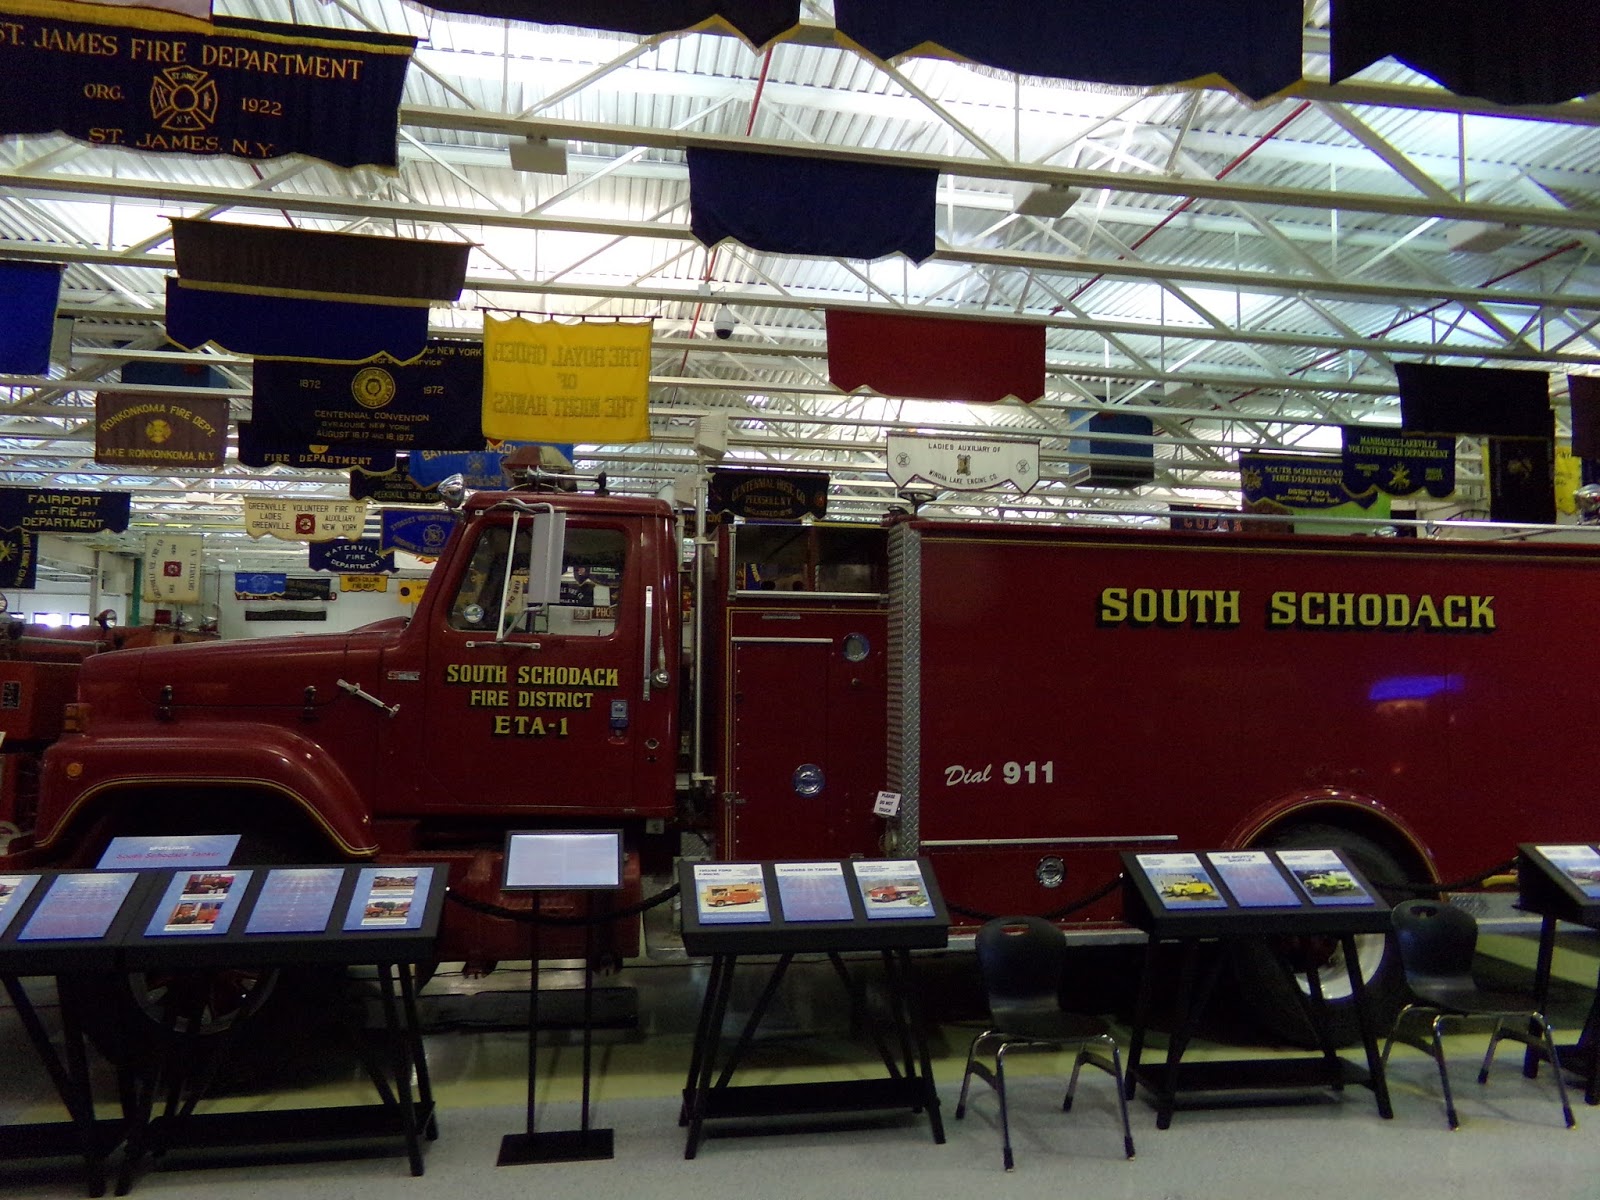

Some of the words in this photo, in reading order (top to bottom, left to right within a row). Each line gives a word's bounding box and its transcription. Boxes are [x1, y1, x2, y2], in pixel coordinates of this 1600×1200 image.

[34, 26, 118, 56] JAMES
[130, 38, 187, 64] FIRE
[201, 44, 364, 80] DEPARTMENT
[83, 83, 125, 100] ORG.
[241, 97, 283, 116] 1922
[88, 127, 125, 144] ST.
[437, 346, 455, 357] NEW
[458, 347, 483, 358] YORK
[300, 379, 321, 389] 1872
[423, 386, 444, 395] 1972
[100, 404, 166, 432] RONKONKOMA
[170, 405, 192, 420] FIRE
[192, 415, 216, 437] DEPT.
[314, 410, 370, 421] CENTENNIAL
[374, 411, 430, 422] CONVENTION
[316, 430, 349, 439] AUGUST
[99, 448, 125, 457] LAKE
[928, 442, 954, 451] LADIES
[957, 444, 990, 453] AUXILIARY
[1348, 444, 1388, 455] VOLUNTEER
[1404, 447, 1449, 458] DEPARTMENT
[264, 453, 290, 462] FIRE
[299, 455, 373, 466] DEPARTMENT
[1264, 465, 1292, 475] SOUTH
[1293, 467, 1344, 477] SCHENECTAD
[949, 475, 963, 484] LAKE
[1271, 474, 1291, 482] FIRE
[1291, 475, 1342, 485] DEPARTMENT
[27, 494, 102, 506] FAIRPORT
[50, 506, 79, 517] FIRE
[248, 502, 287, 512] GREENVILLE
[293, 503, 329, 513] VOLUNTEER
[335, 504, 349, 513] FIRE
[22, 516, 104, 529] DEPARTMENT
[259, 512, 282, 521] LADIES
[325, 513, 356, 523] AUXILIARY
[251, 521, 290, 531] GREENVILLE
[321, 522, 336, 531] NEW
[342, 523, 358, 532] YORK
[331, 559, 380, 569] DEPARTMENT
[1101, 587, 1241, 624] SOUTH
[1270, 590, 1496, 629] SCHODACK
[446, 664, 508, 684] SOUTH
[517, 665, 619, 687] SCHODACK
[470, 689, 509, 707] FIRE
[517, 690, 594, 708] DISTRICT
[493, 715, 570, 736] ETA-1
[944, 763, 993, 786] Dial
[1002, 760, 1054, 785] 911
